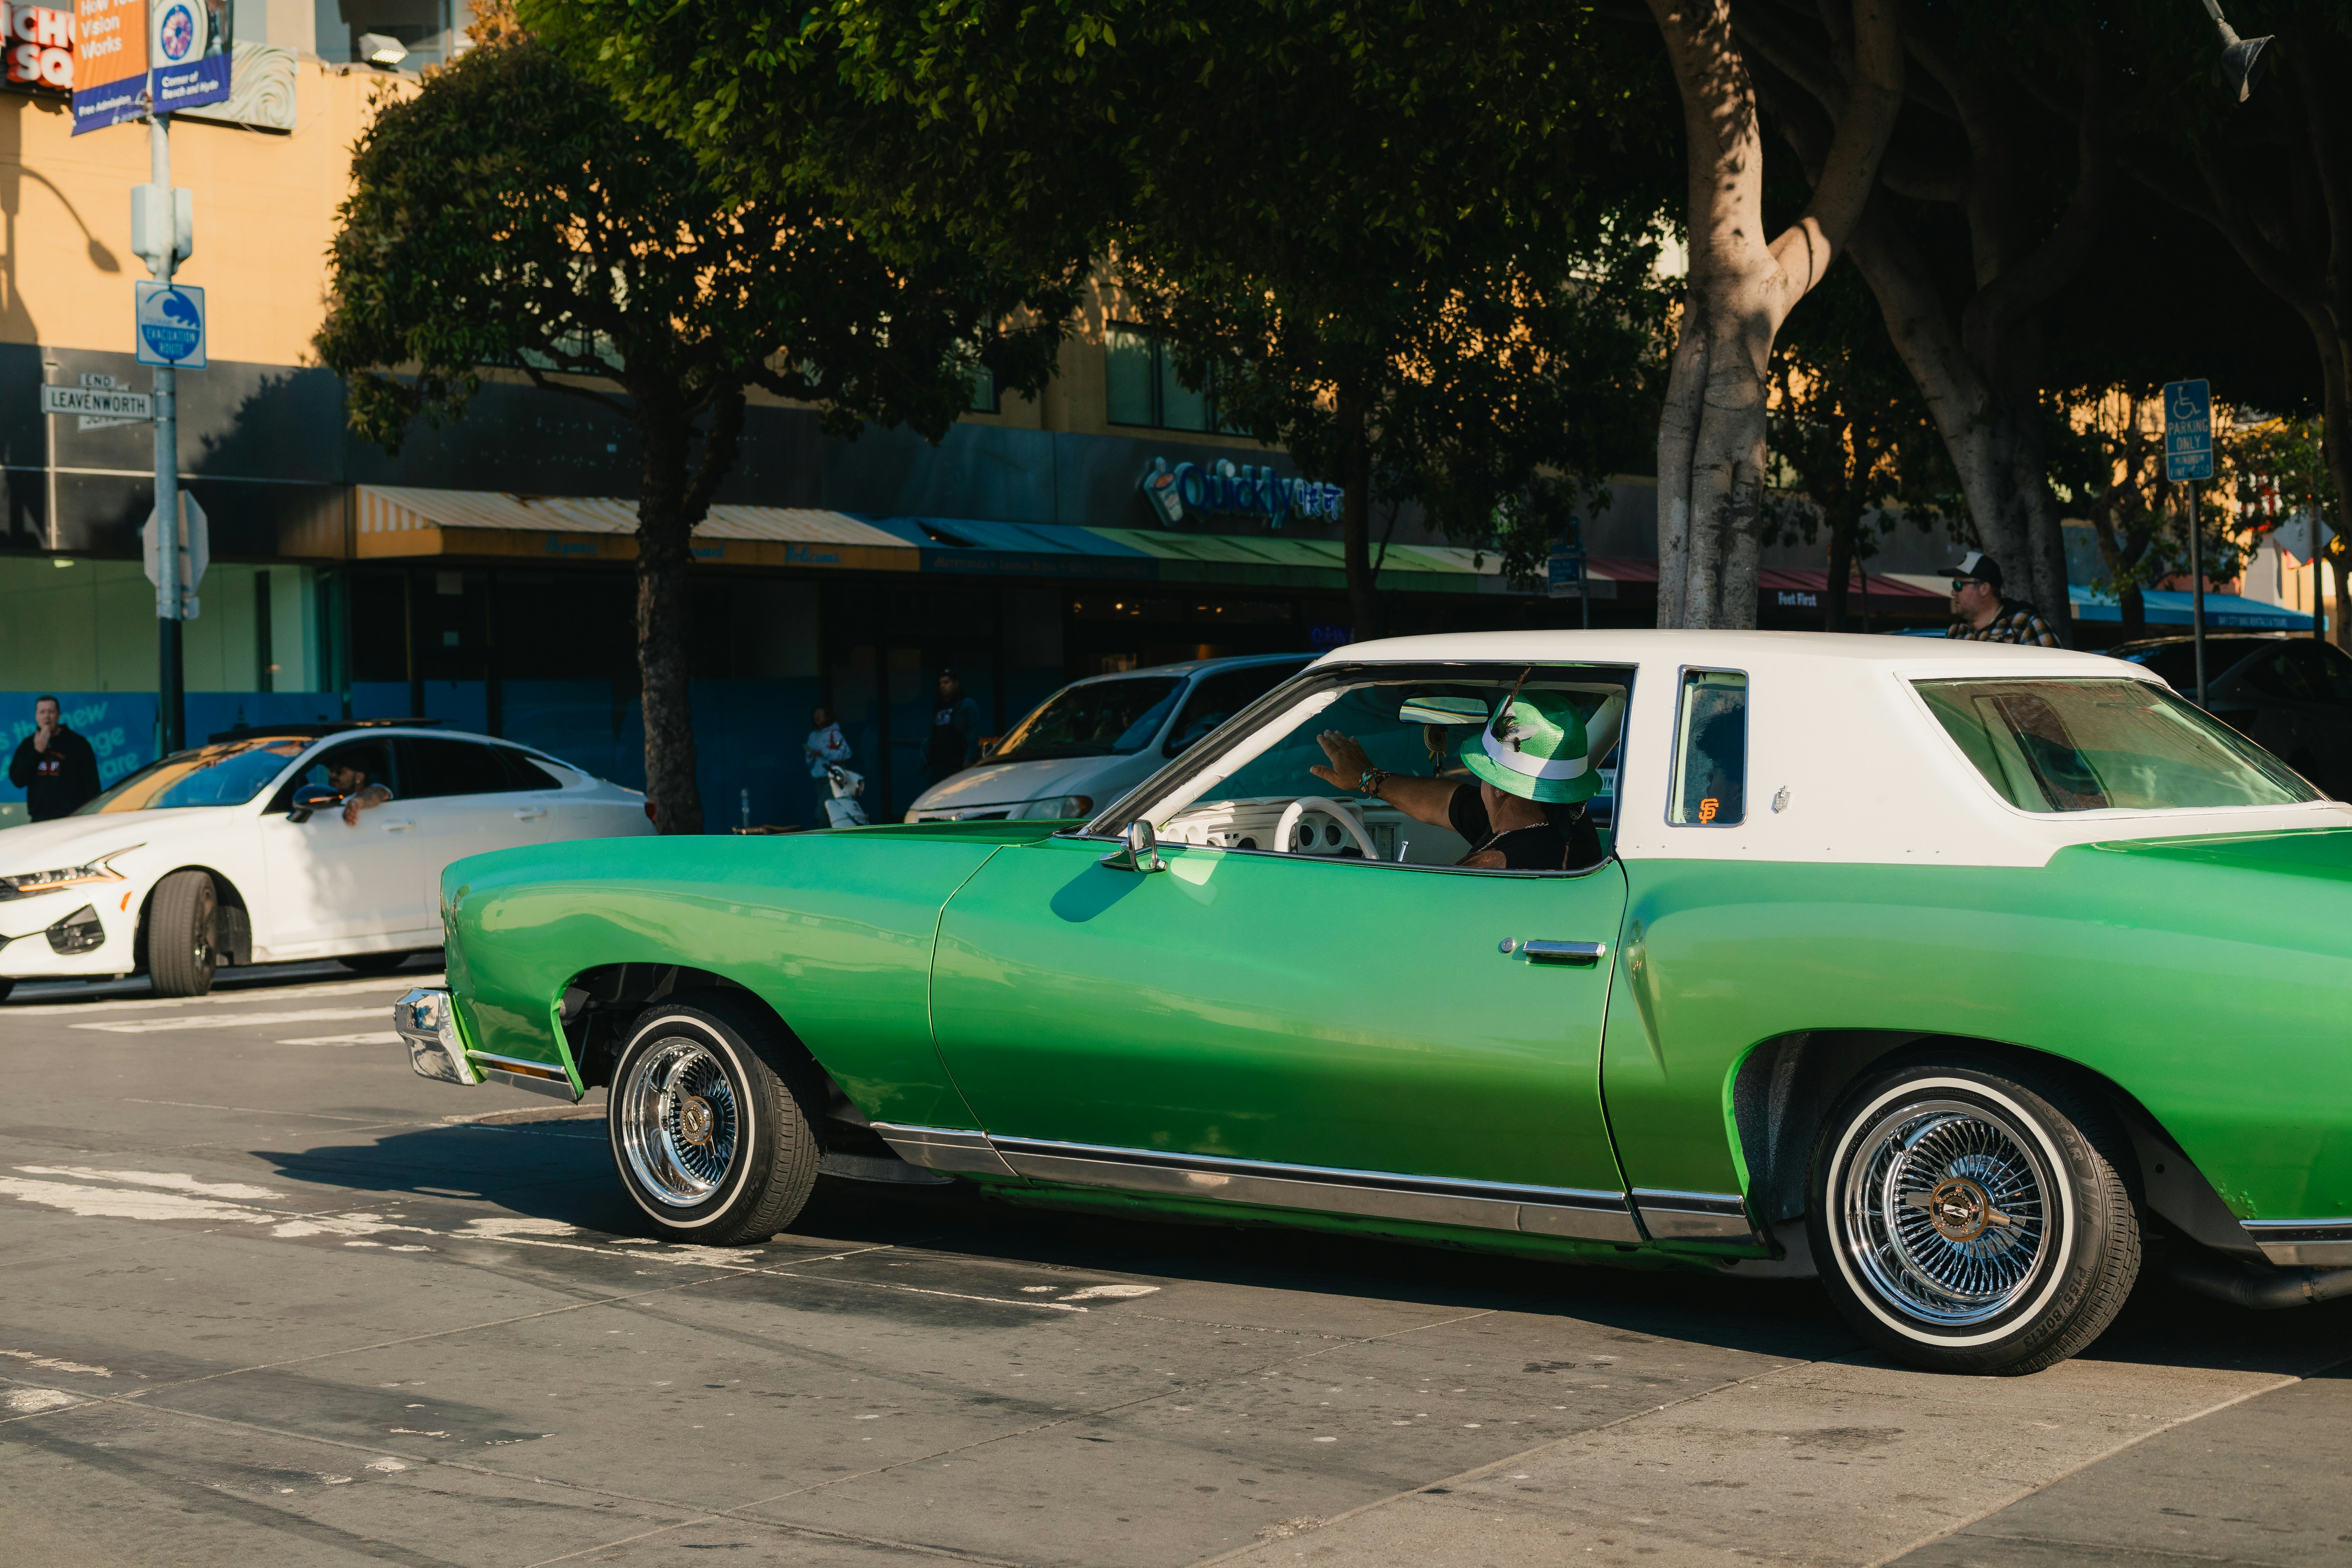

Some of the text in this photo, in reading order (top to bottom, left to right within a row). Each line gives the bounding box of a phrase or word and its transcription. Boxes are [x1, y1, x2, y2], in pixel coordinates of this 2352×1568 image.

[81, 15, 120, 38] Vision
[80, 36, 122, 60] Works
[79, 105, 95, 117] Free
[95, 94, 131, 110] Admission
[146, 327, 196, 343] EVACUATION
[159, 343, 183, 356] ROUTE
[85, 374, 111, 388] END
[51, 392, 146, 413] LEAVENWORTH
[2168, 418, 2209, 436] PARKING
[2176, 435, 2201, 451] ONLY
[1180, 460, 1292, 523] Quickly
[545, 534, 598, 557] Organic
[785, 545, 839, 563] Delicious
[1797, 592, 1817, 607] First
[1698, 798, 1719, 824] SF
[2023, 1265, 2087, 1352] P155/80R13
